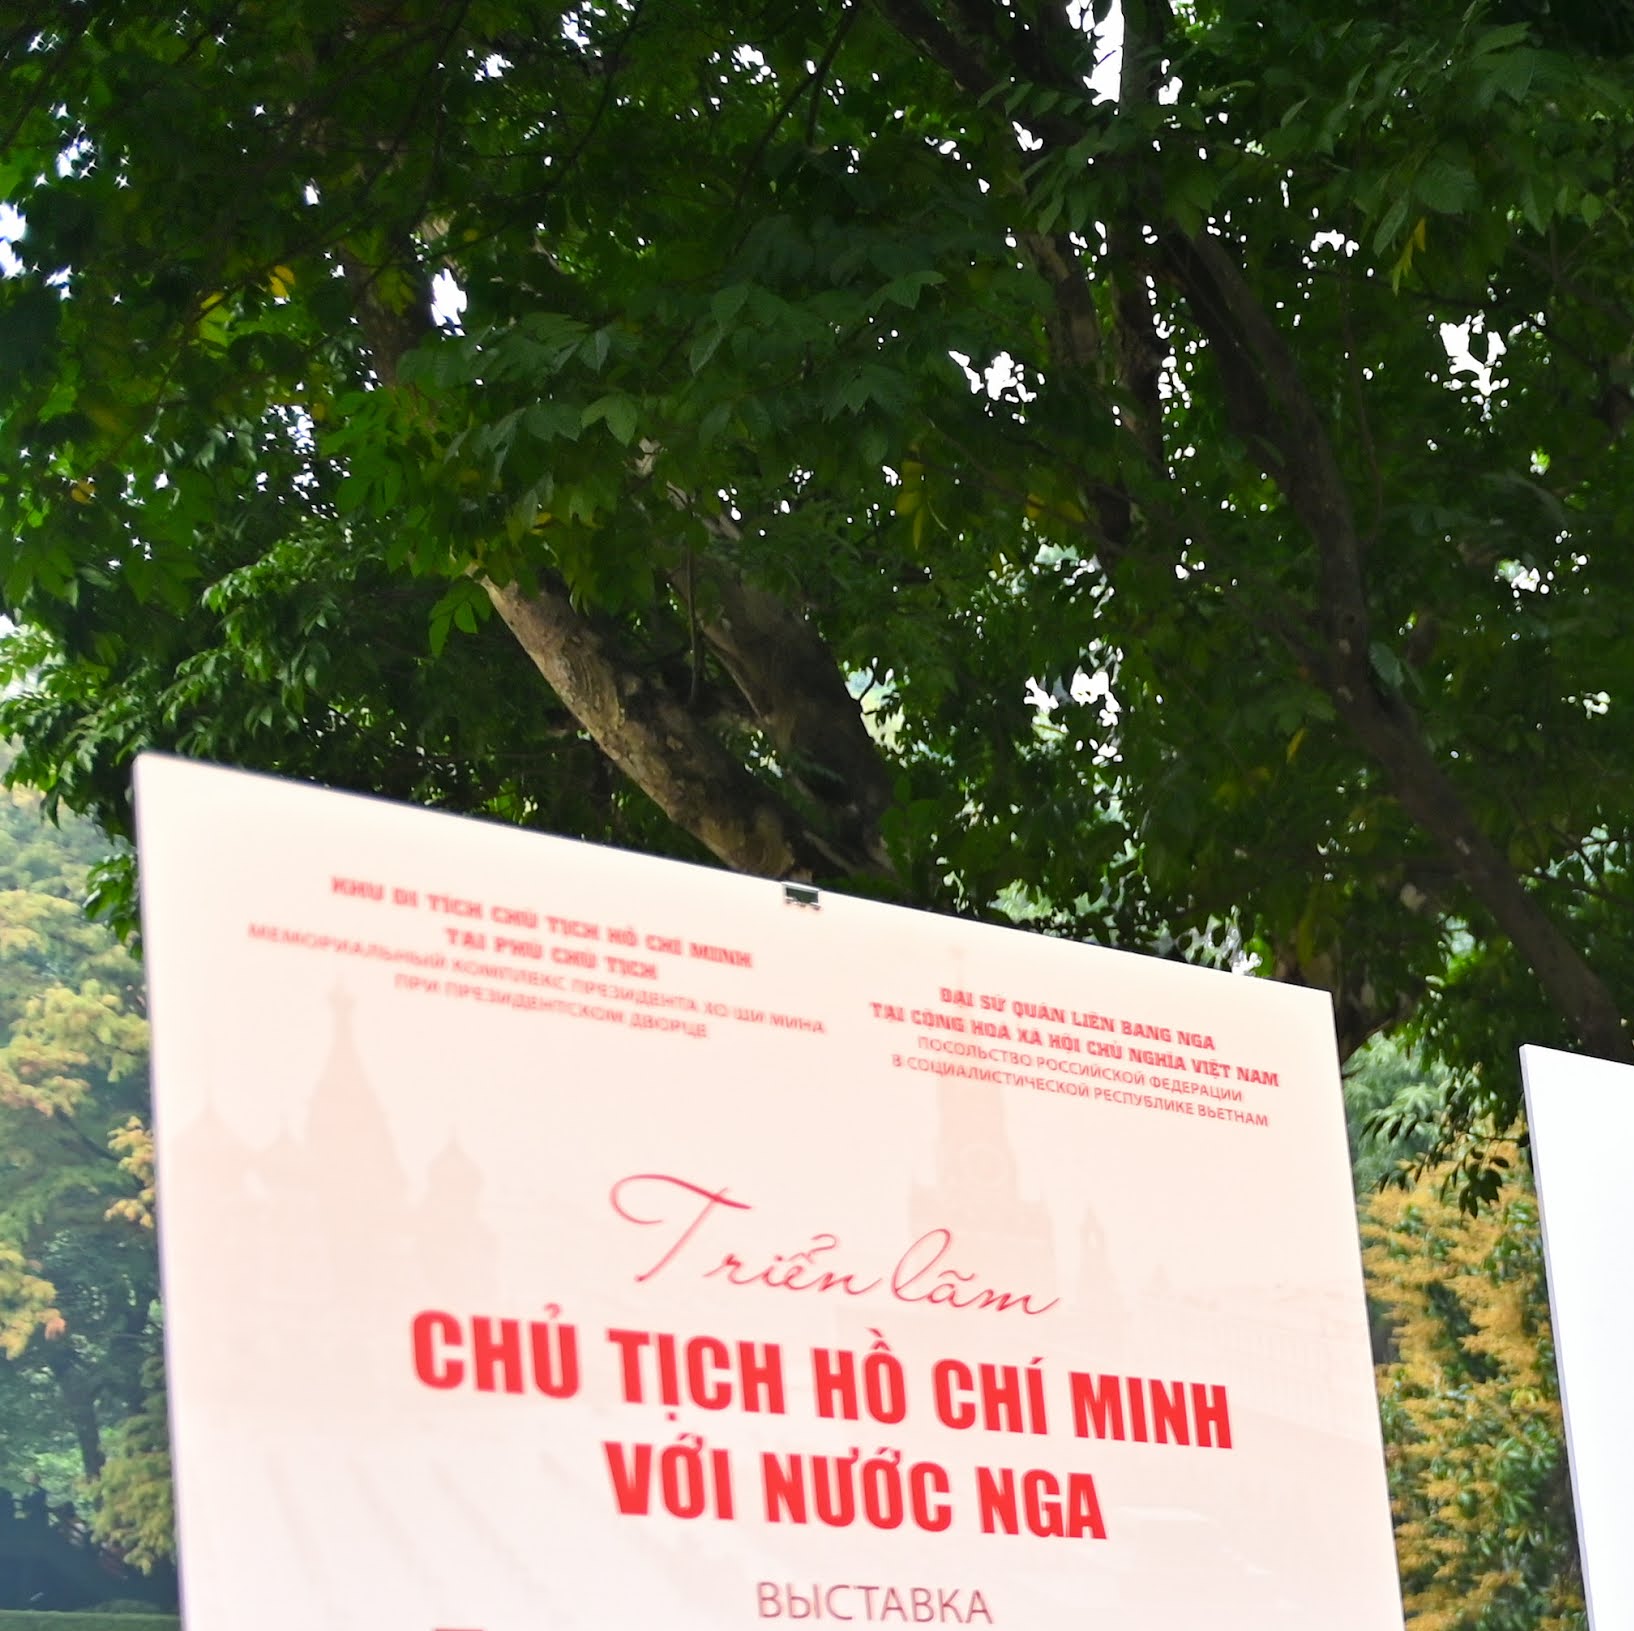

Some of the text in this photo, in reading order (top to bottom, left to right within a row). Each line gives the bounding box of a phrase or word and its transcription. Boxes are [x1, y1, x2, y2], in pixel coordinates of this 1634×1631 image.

[608, 1173, 1060, 1315] Triển lãm
[410, 1302, 1232, 1449] CHỦ TỊCH HỒ CHÍ MINH
[602, 1432, 1107, 1540] VỚI NƯỚC NGA
[756, 1581, 993, 1624] ВЫСТАВКА
